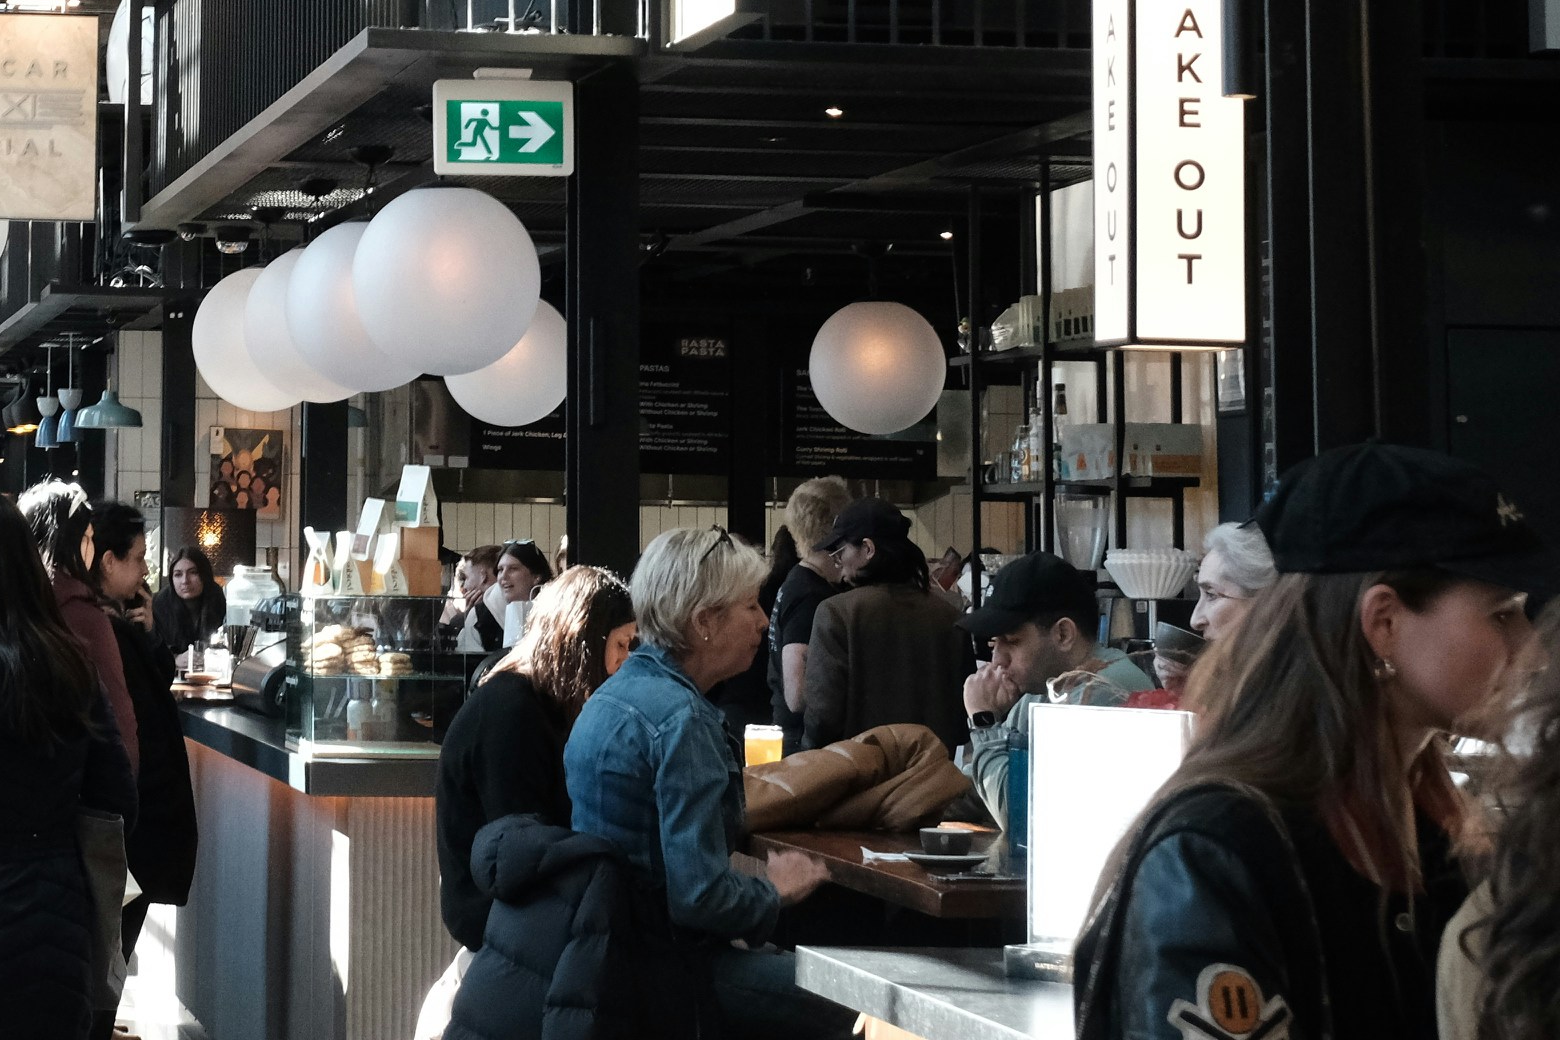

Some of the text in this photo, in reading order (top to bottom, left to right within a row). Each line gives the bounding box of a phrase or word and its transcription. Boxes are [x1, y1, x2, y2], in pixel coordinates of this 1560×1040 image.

[1106, 161, 1117, 287] OUT
[1173, 159, 1205, 285] OUT
[681, 339, 725, 348] RASTA
[681, 347, 725, 357] PASTA
